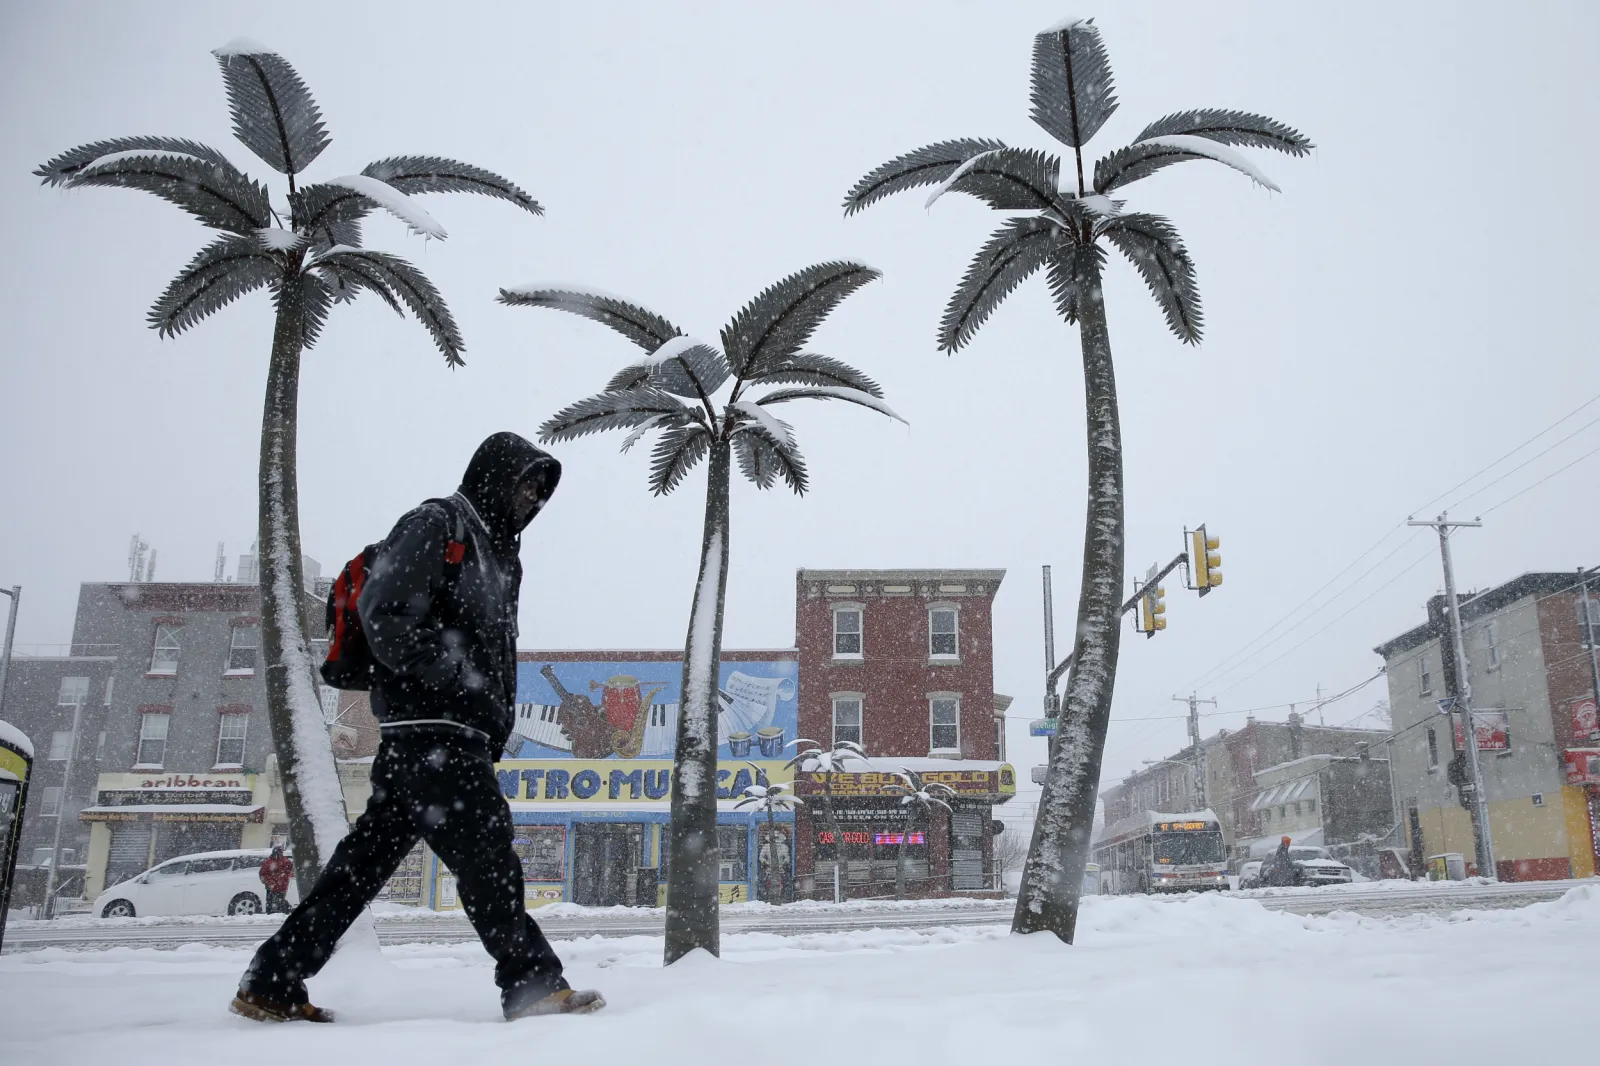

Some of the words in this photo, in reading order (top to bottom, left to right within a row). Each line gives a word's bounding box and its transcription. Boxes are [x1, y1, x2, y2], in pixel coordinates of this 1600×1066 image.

[1036, 720, 1058, 730] Lehig
[141, 775, 241, 788] aribbean
[496, 769, 602, 800] NTRO
[608, 769, 767, 800] MUCA
[811, 773, 855, 784] WE
[861, 773, 908, 784] BU
[921, 772, 989, 784] GOLD
[818, 831, 835, 844] CAS
[851, 831, 870, 844] GOLD
